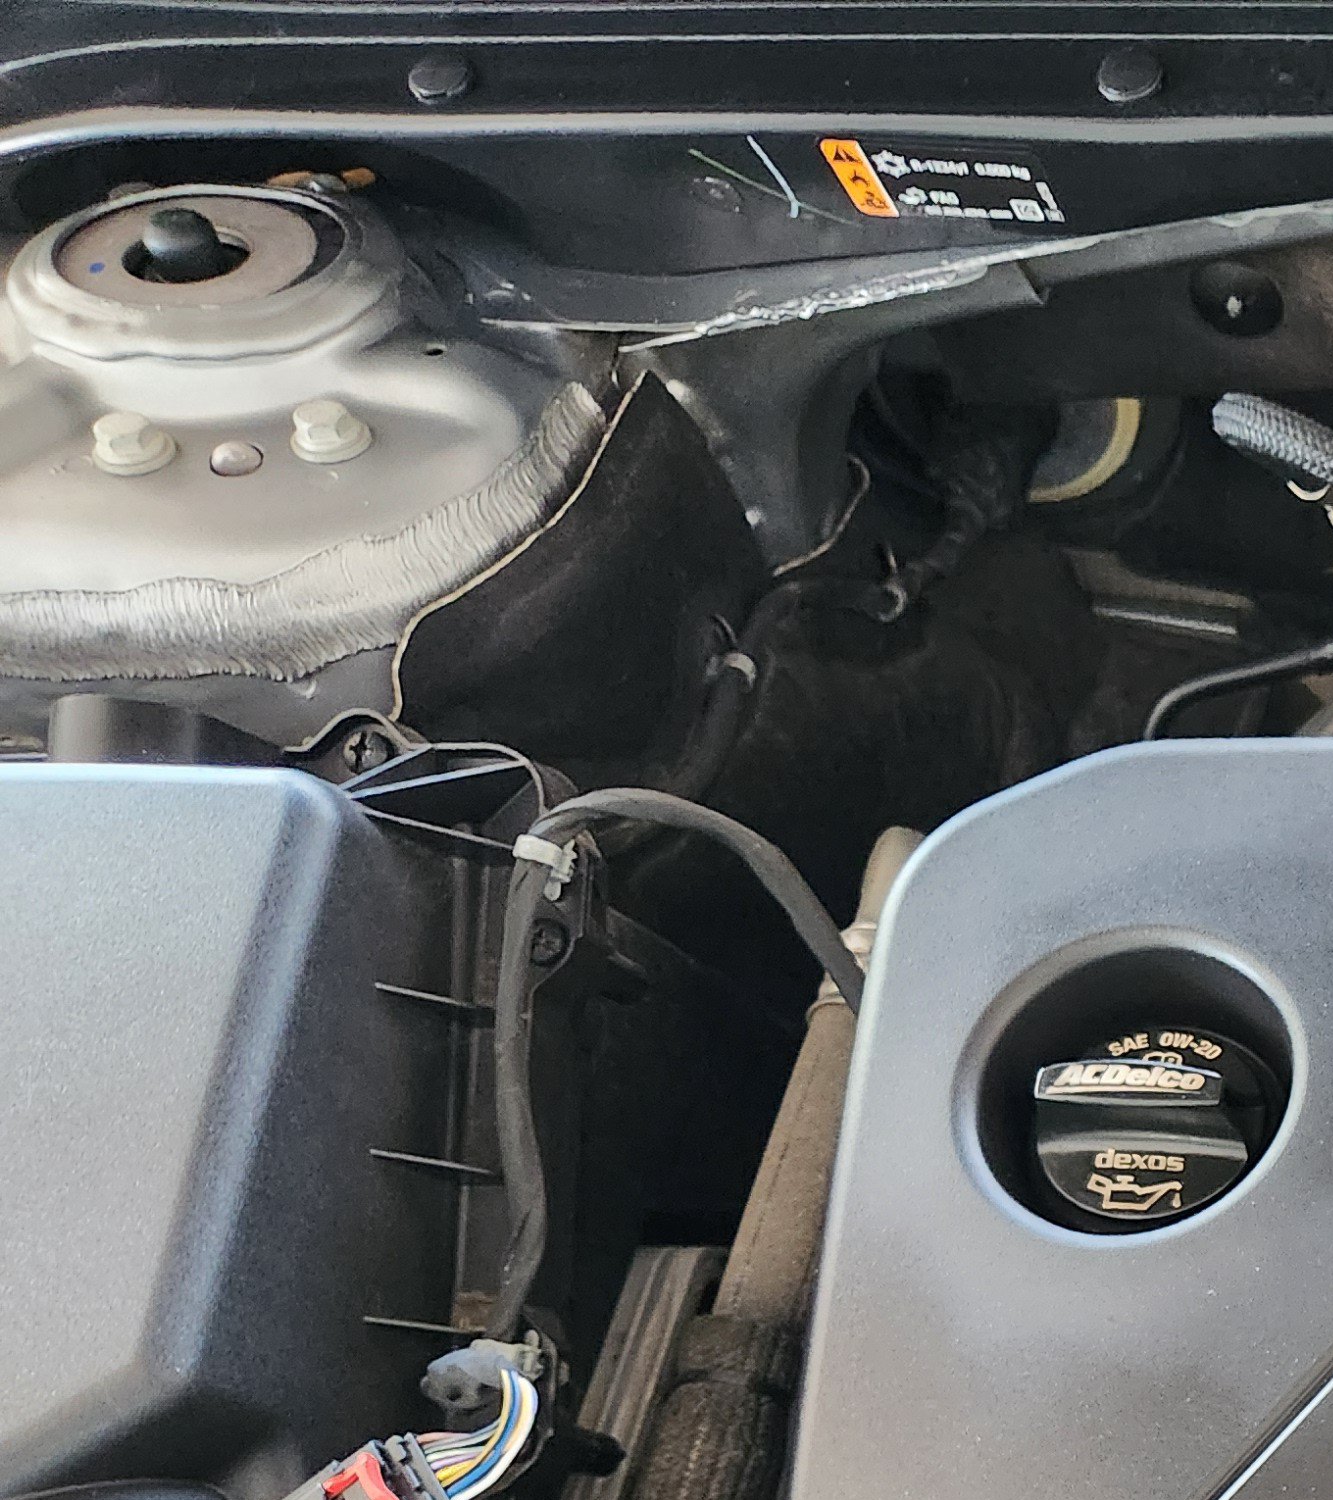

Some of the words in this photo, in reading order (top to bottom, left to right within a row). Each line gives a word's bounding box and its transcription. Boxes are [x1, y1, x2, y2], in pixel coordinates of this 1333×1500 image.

[1108, 1033, 1150, 1057] SAE
[1159, 1031, 1222, 1060] 0W-20
[1053, 1064, 1206, 1091] ACDelco
[1094, 1148, 1186, 1173] dexos
